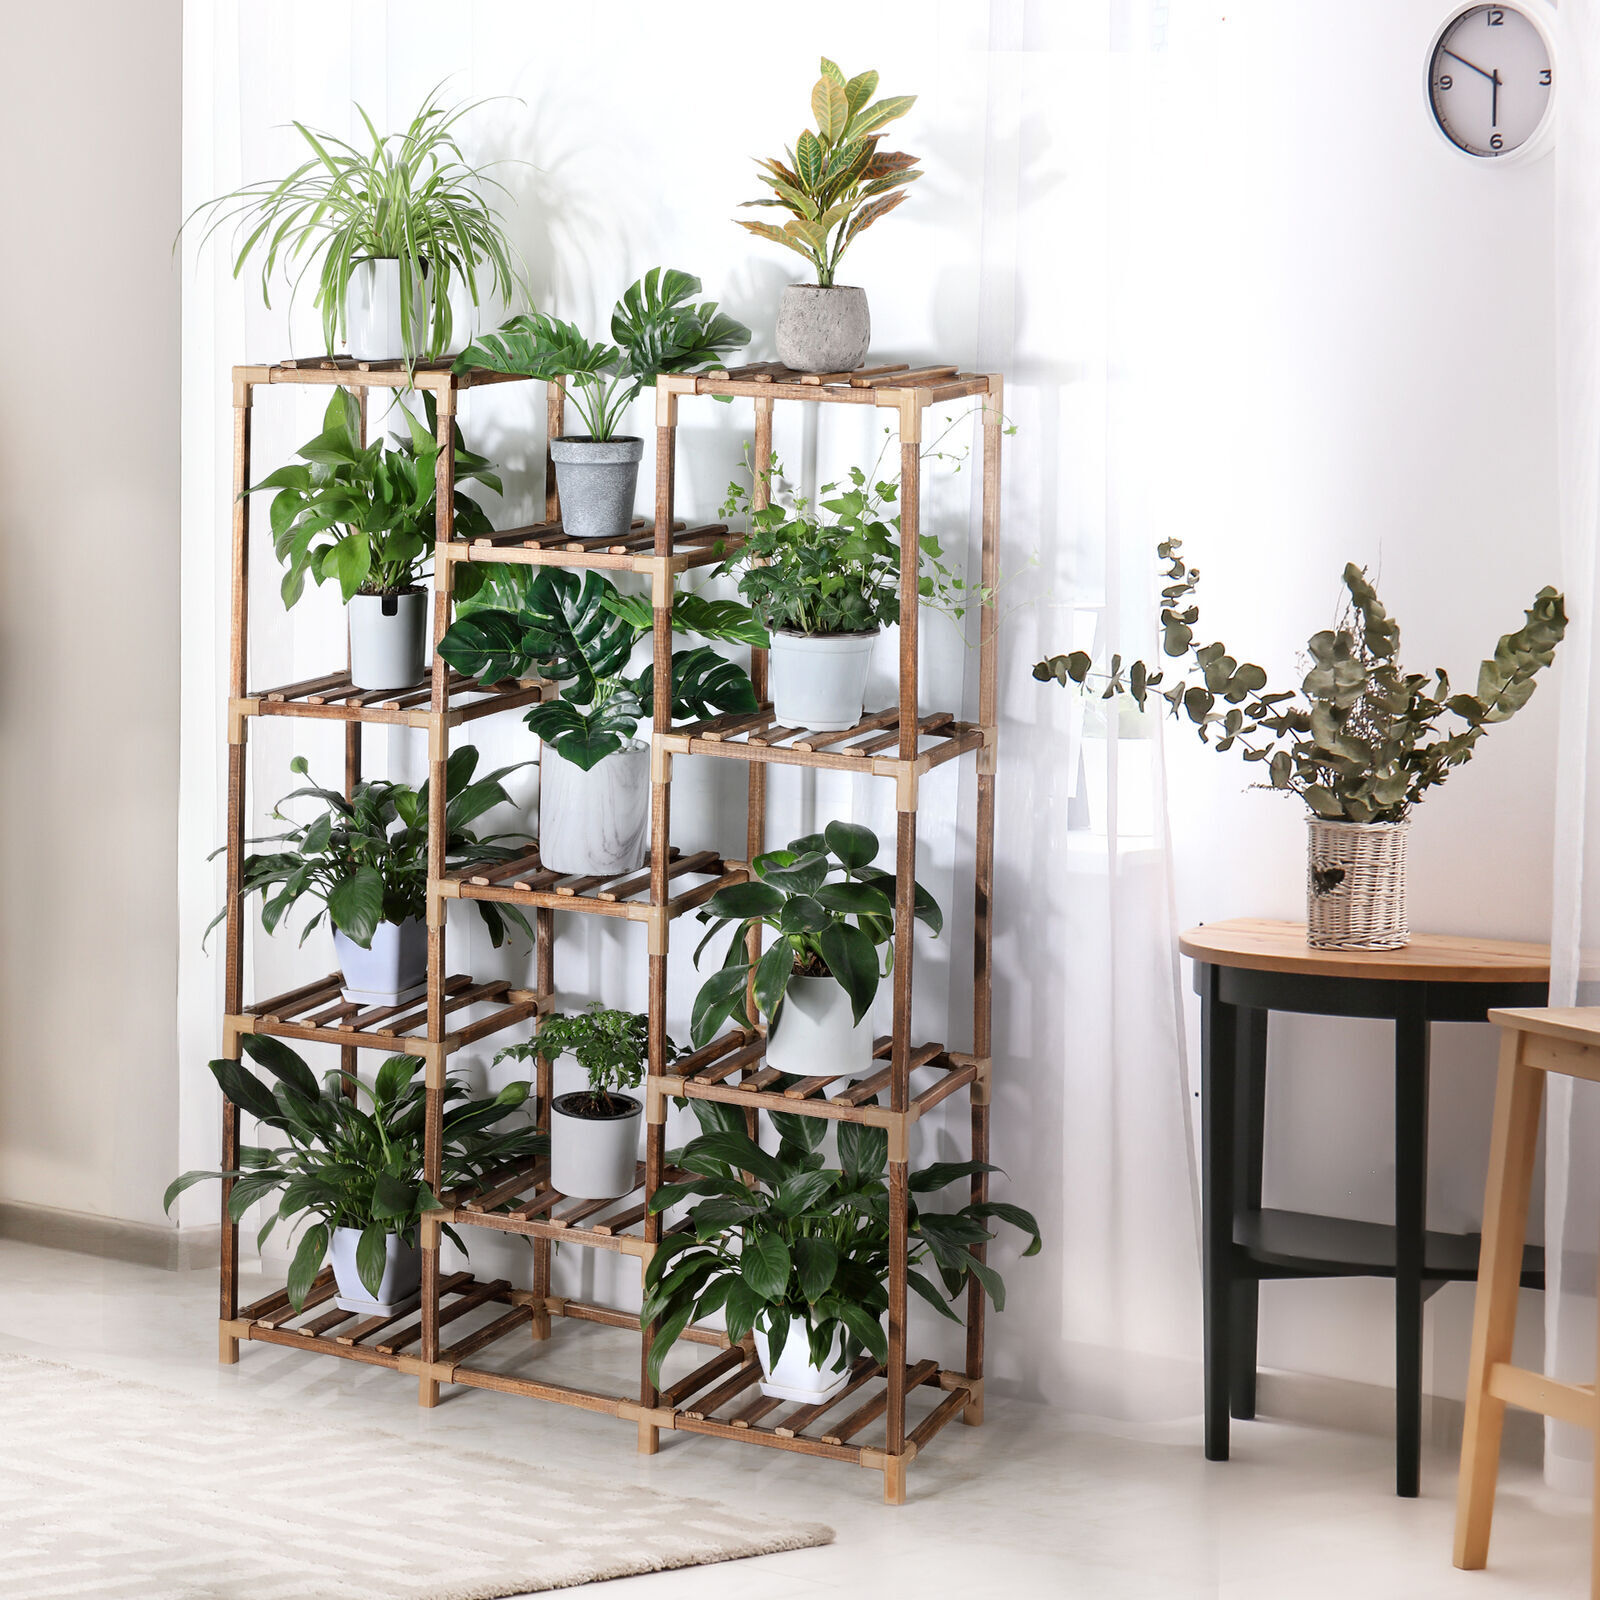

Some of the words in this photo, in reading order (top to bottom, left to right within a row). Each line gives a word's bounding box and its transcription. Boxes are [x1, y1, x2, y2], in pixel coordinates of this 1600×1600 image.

[1487, 11, 1504, 26] 12
[1439, 75, 1453, 91] 9
[1539, 69, 1552, 86] 3
[1490, 134, 1503, 149] 6
